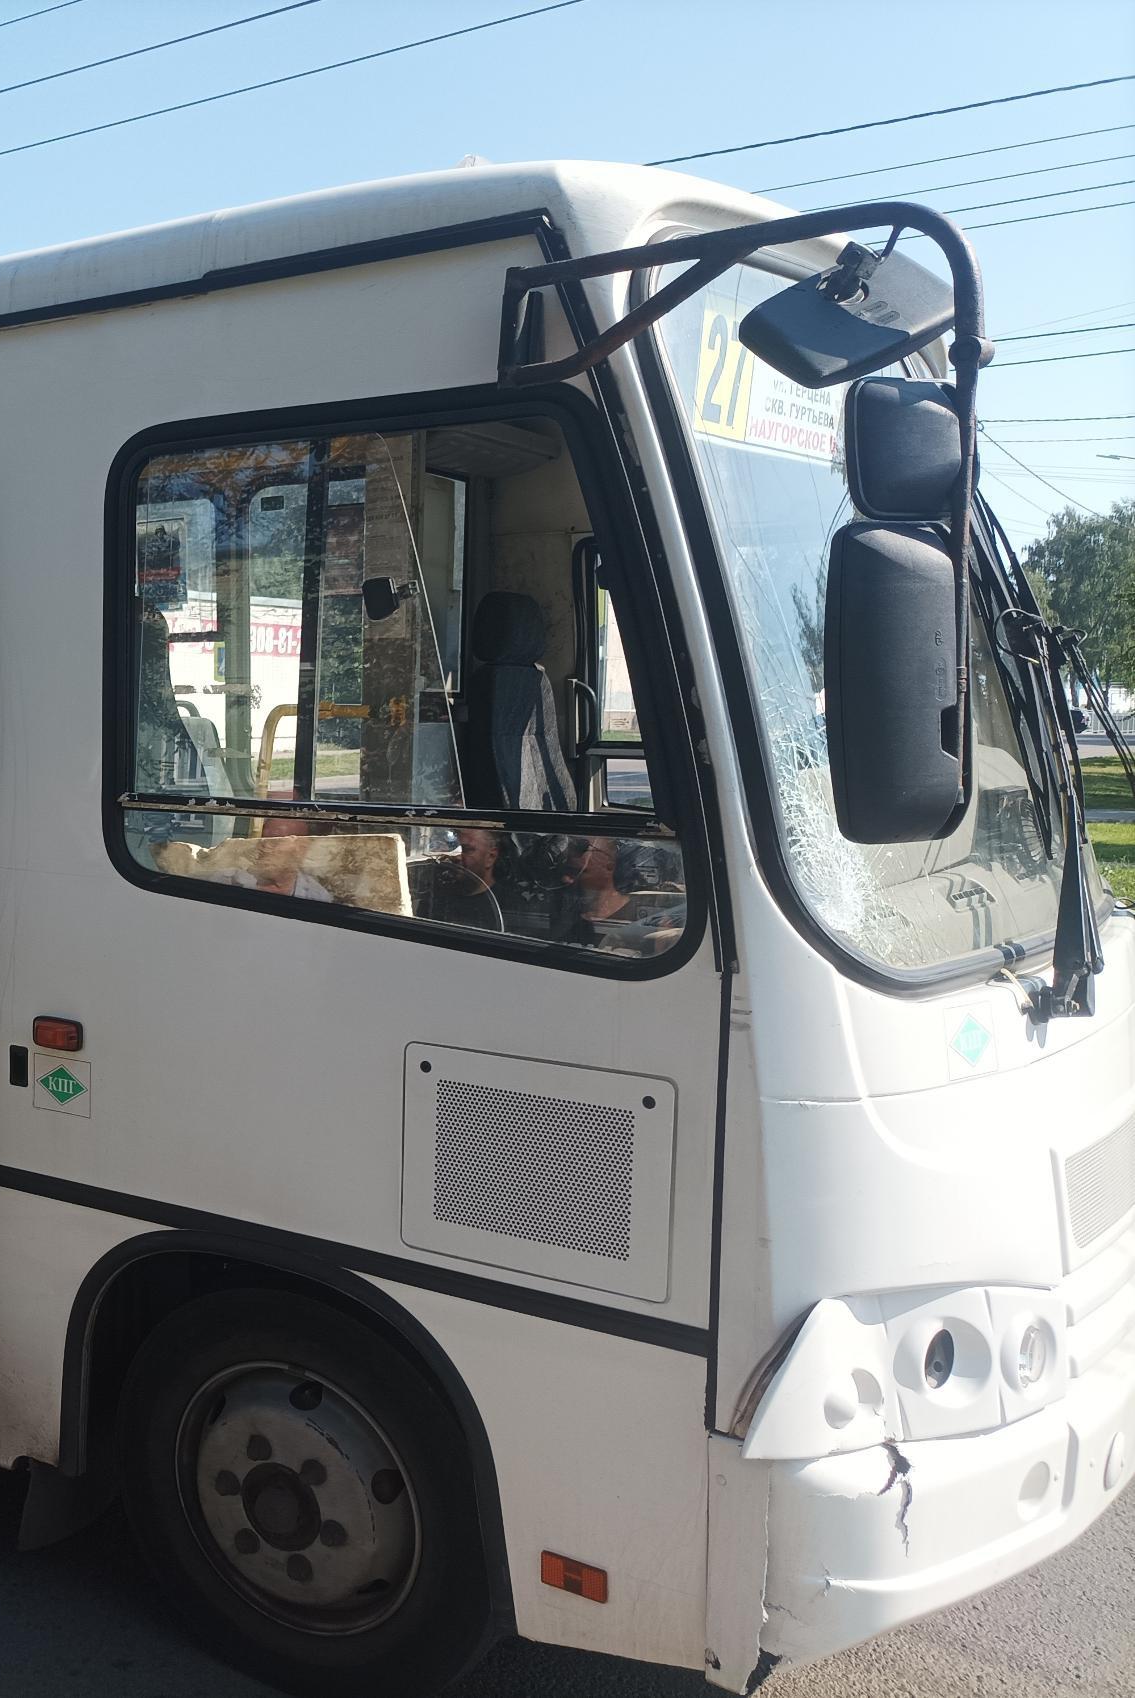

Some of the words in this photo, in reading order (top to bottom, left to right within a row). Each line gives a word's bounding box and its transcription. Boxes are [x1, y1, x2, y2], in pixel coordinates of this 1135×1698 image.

[702, 314, 747, 427] 27
[789, 403, 835, 430] ГУРТЬЕВА
[749, 416, 827, 451] НАУГОРСКОЕ
[48, 1076, 76, 1094] КПГ
